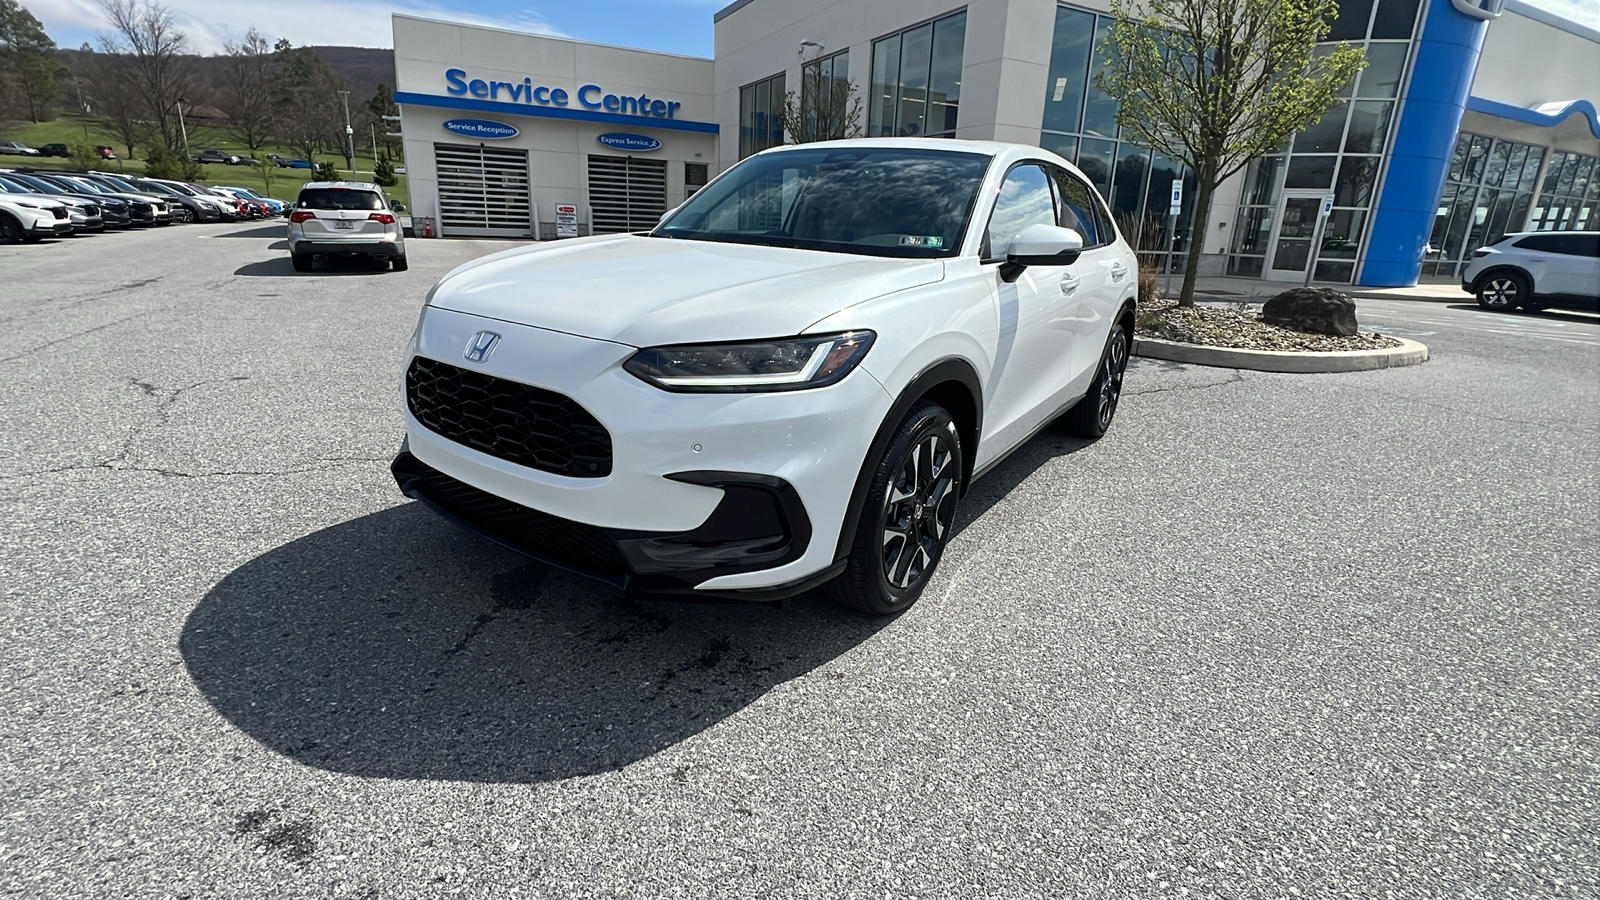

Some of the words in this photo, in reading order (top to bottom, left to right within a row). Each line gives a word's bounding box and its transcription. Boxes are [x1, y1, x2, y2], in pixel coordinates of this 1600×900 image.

[445, 68, 568, 106] Service
[577, 84, 681, 118] Center
[447, 122, 476, 131] Service
[477, 125, 515, 134] Reception
[600, 136, 625, 144] Express
[626, 138, 649, 146] Service
